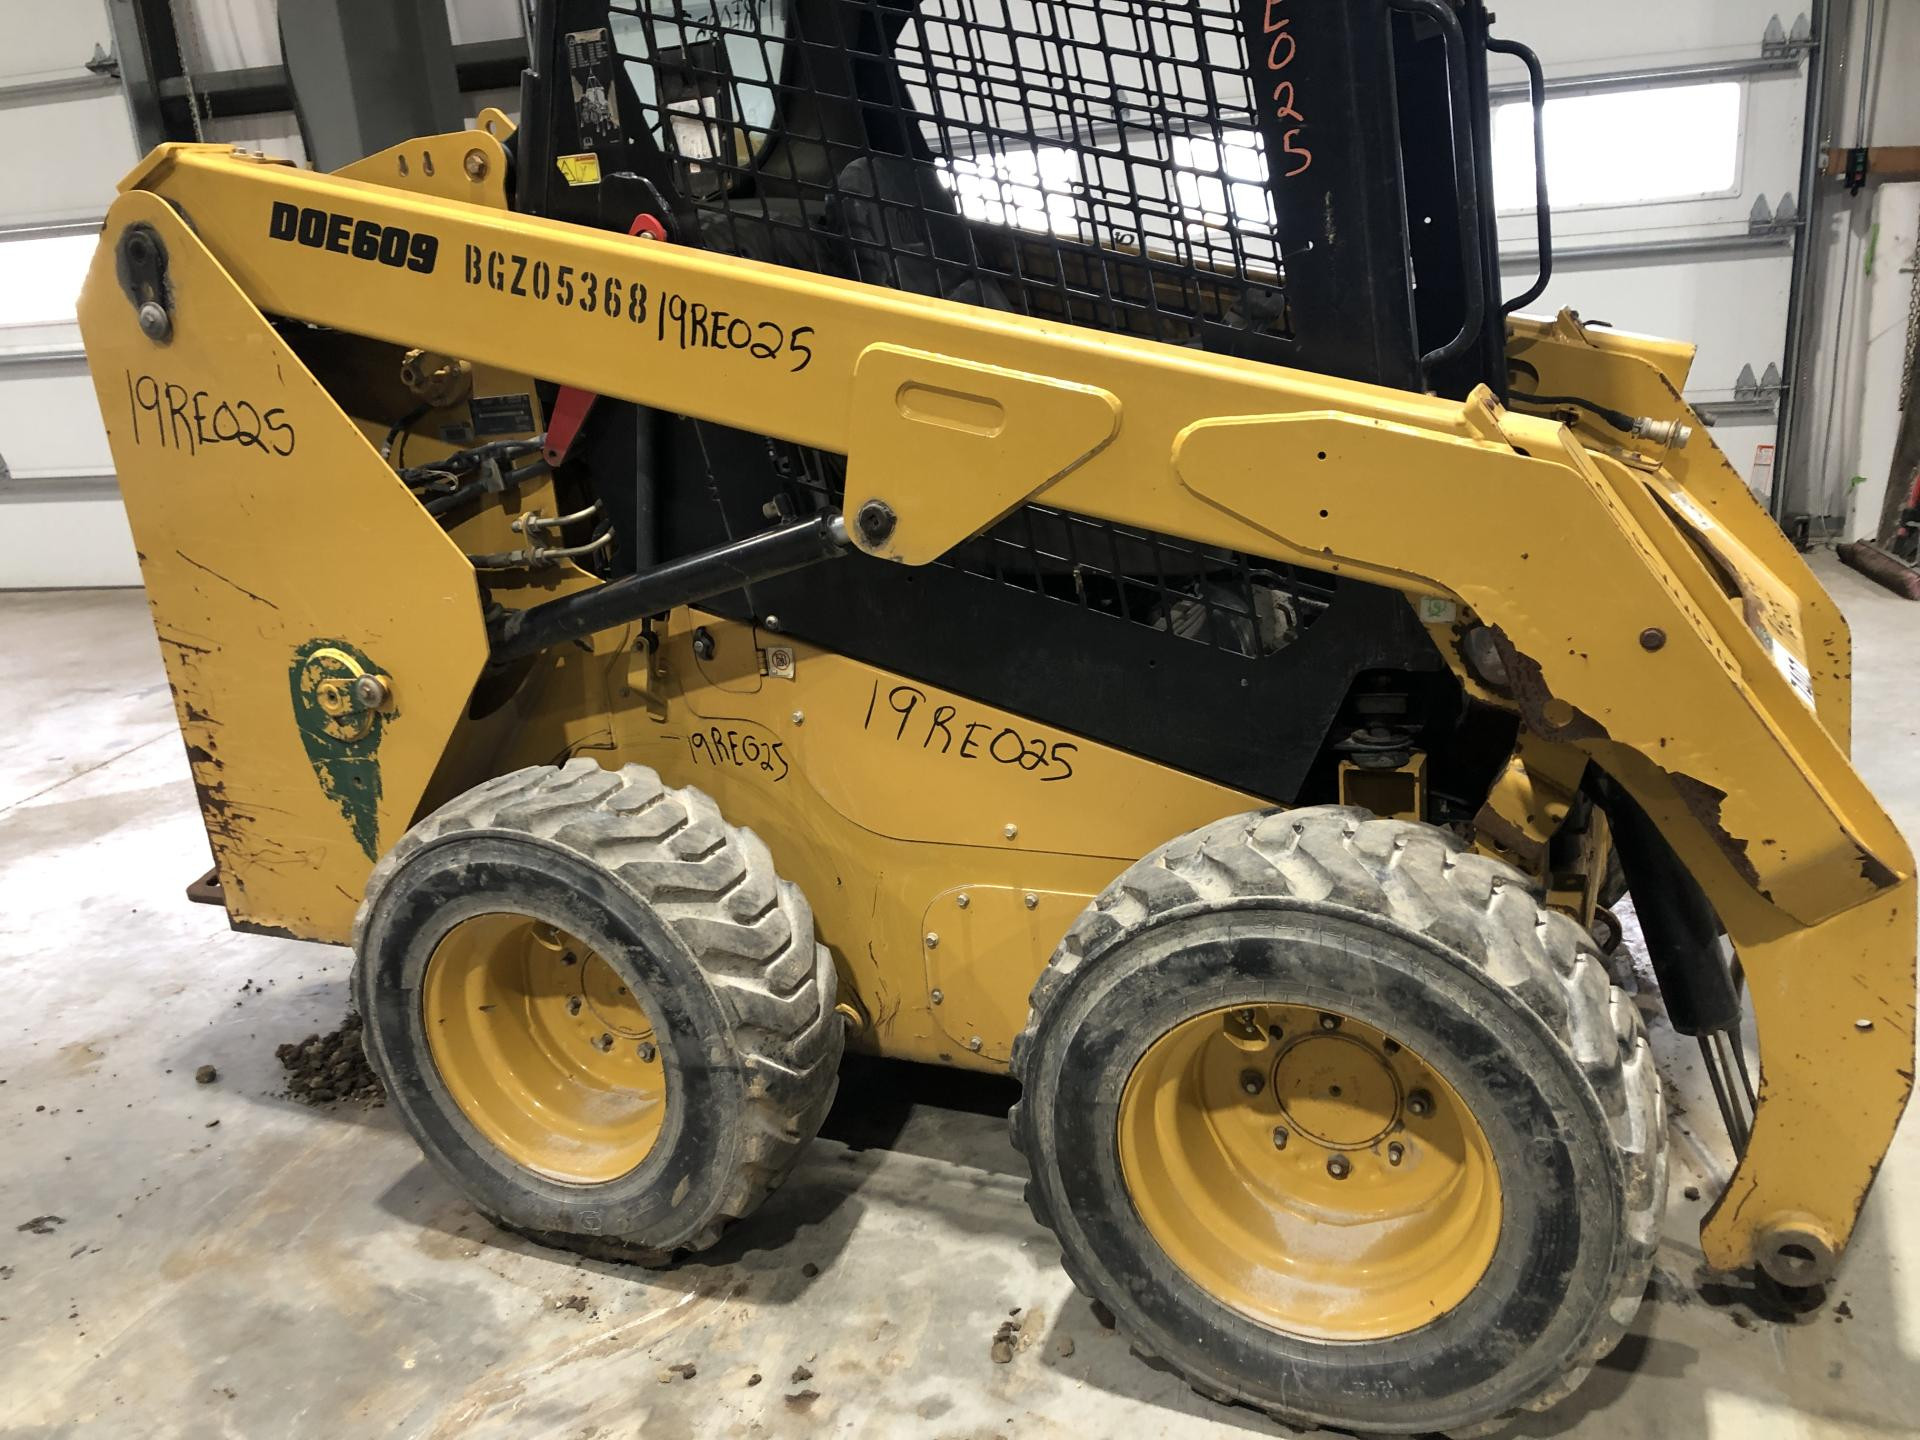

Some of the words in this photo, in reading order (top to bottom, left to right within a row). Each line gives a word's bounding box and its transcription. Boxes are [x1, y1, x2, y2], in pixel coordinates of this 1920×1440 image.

[269, 201, 438, 274] DOE609
[465, 244, 648, 324] BGZ05368
[658, 292, 815, 372] 19RE025
[127, 369, 295, 456] 19RE025
[865, 680, 1078, 781] 19RE025
